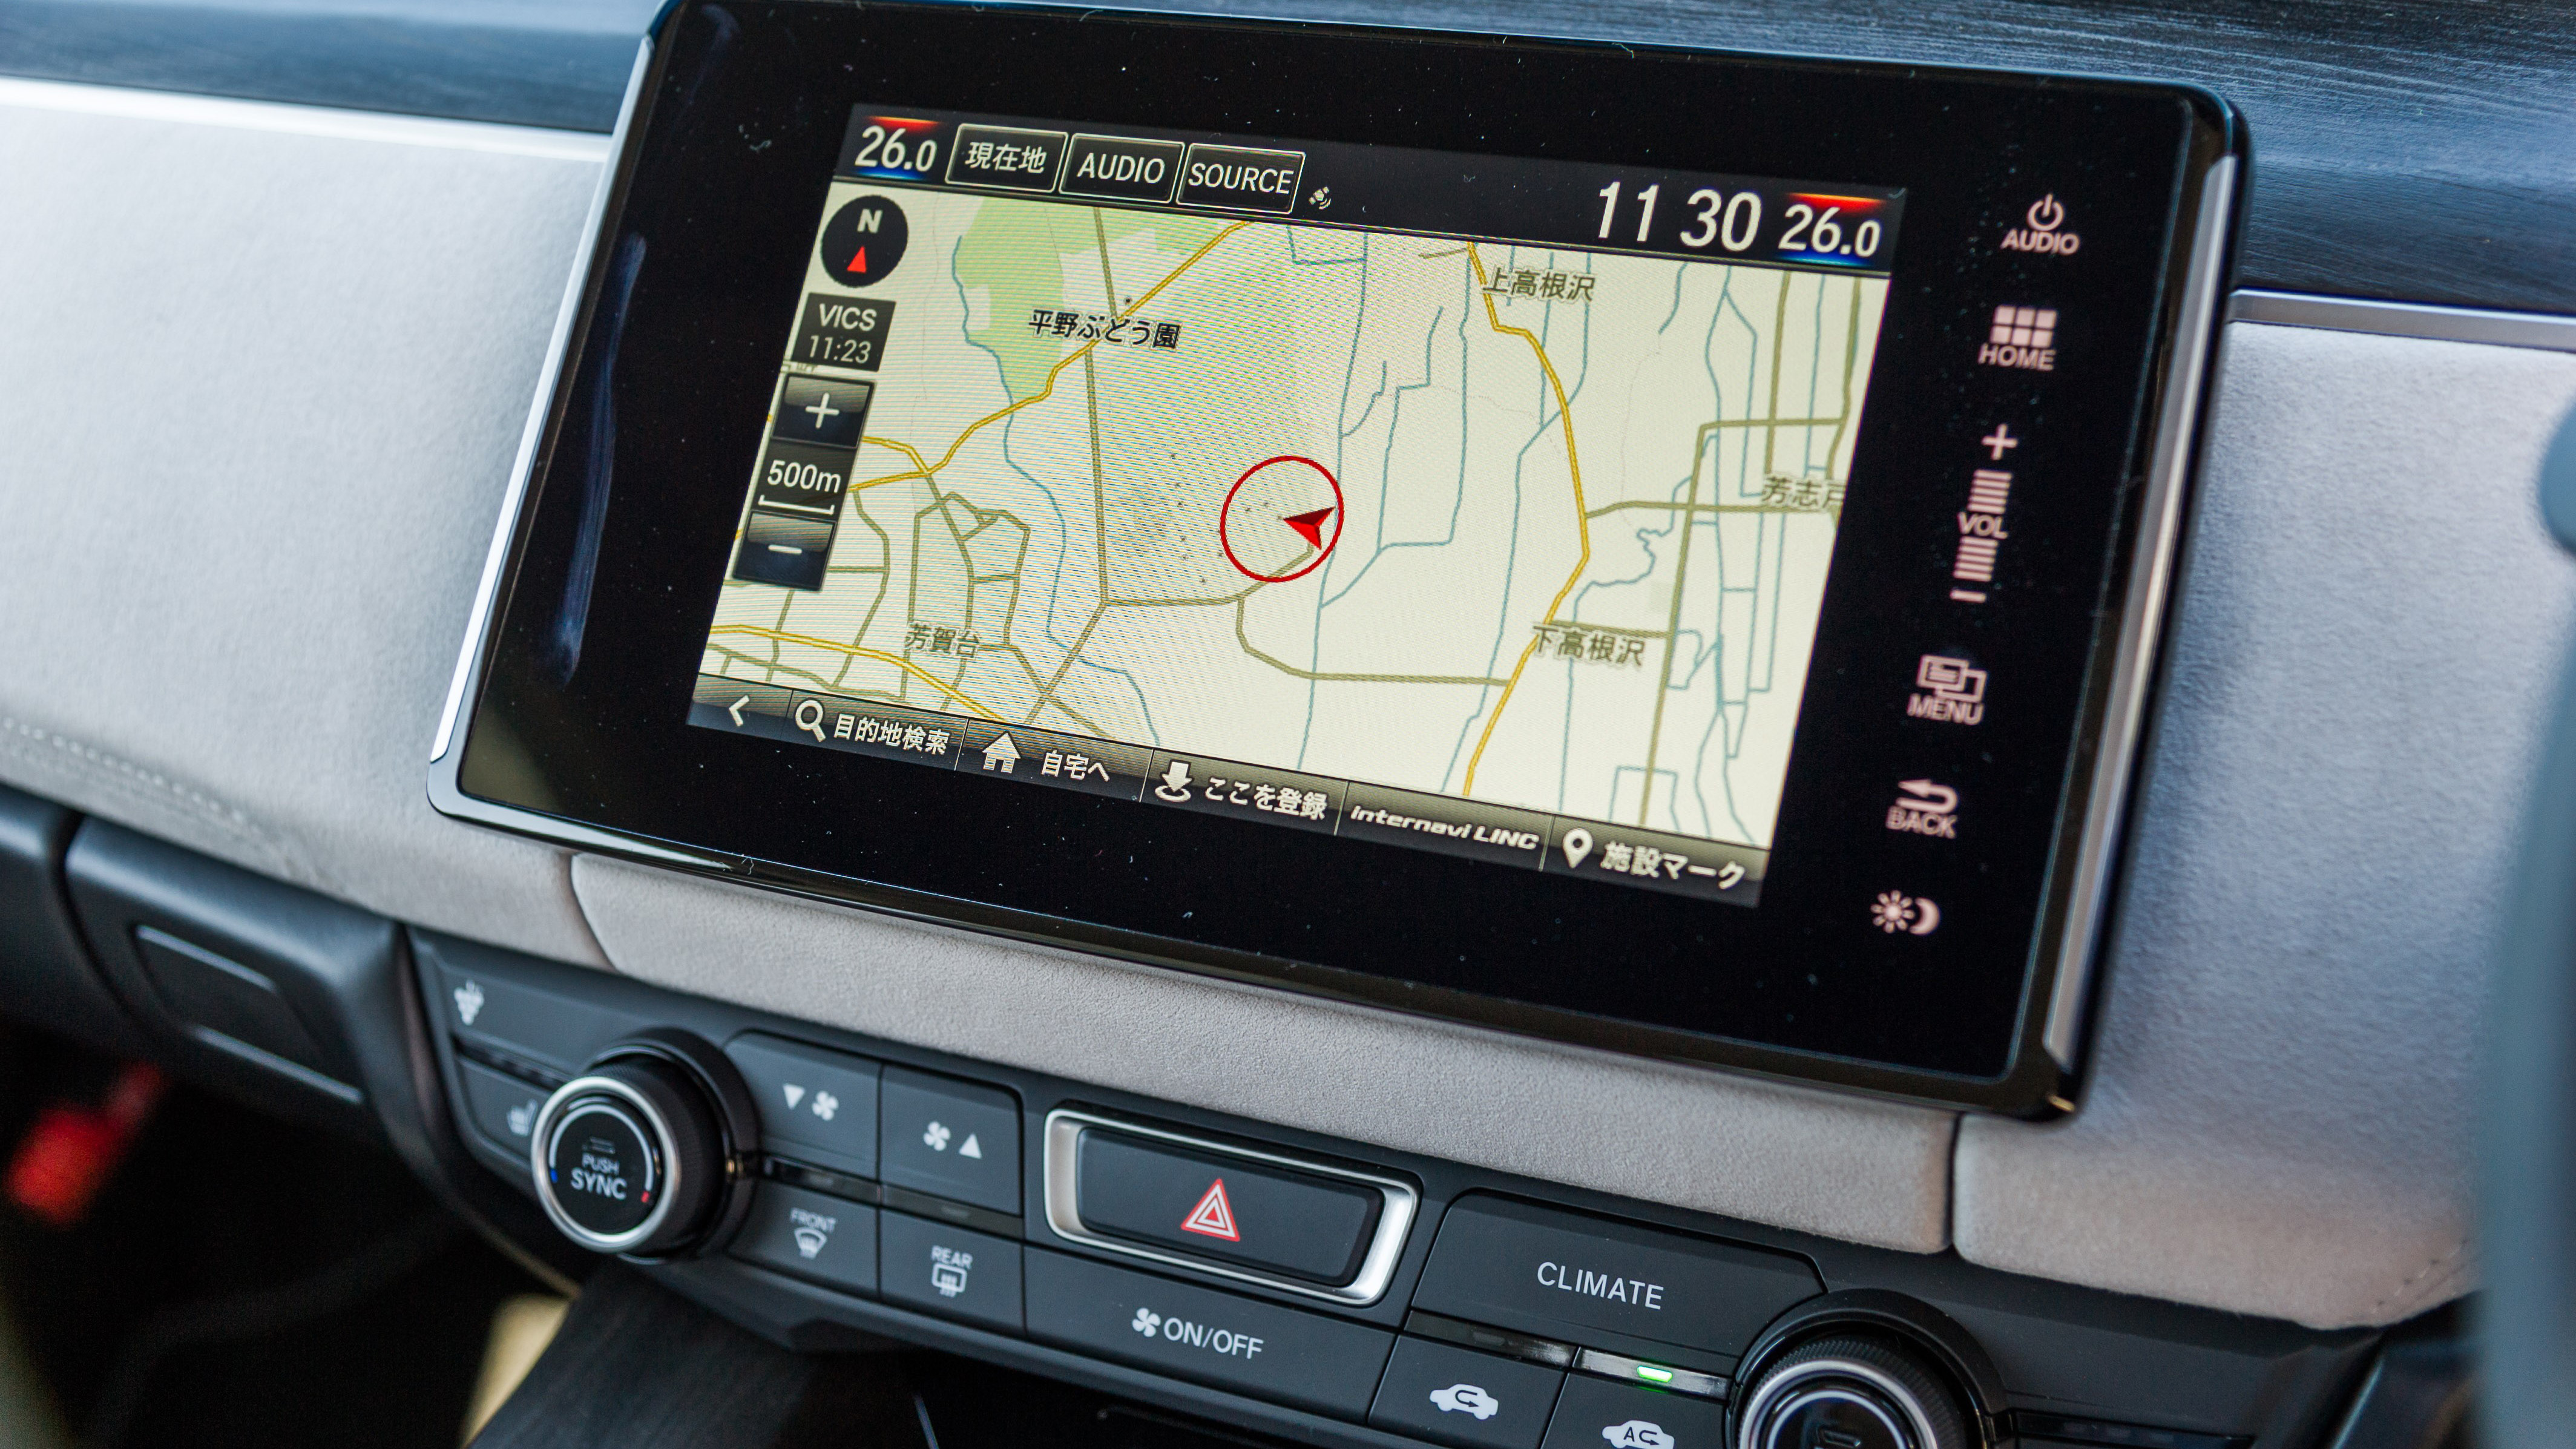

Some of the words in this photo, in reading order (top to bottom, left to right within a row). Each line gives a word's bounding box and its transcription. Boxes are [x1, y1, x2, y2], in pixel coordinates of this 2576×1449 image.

[855, 125, 938, 172] 26.0
[964, 142, 1047, 175] 現在地
[1076, 152, 1166, 184] AUDIO
[1188, 162, 1294, 196] SOURCE
[858, 208, 883, 234] N
[1598, 181, 1661, 242] 11
[1680, 189, 1762, 252] 30
[1778, 203, 1881, 258] 26.0
[2000, 228, 2080, 255] AUDIO
[1482, 266, 1597, 302] 上高根沢
[818, 303, 877, 330] VICS
[1028, 308, 1181, 351] 平野ぶどう園
[809, 335, 872, 364] 11:23
[1977, 343, 2056, 372] HOME
[767, 459, 842, 493] 500m
[1957, 511, 2009, 540] VOL
[904, 623, 980, 660] 芳賀台
[1531, 624, 1646, 667] 下高根沢
[1907, 692, 1985, 726] MENU
[833, 714, 951, 756] 目的地検索
[1040, 749, 1110, 783] 自宅へ
[1204, 777, 1329, 821] ここを登録
[1473, 825, 1539, 851] LINC
[1885, 805, 1957, 840] BACK
[1600, 842, 1746, 889] 施設マーク
[582, 1152, 620, 1175] PUSH
[571, 1168, 627, 1200] SYNC
[790, 1208, 837, 1234] FRONT
[931, 1245, 973, 1270] REAR
[1536, 1261, 1665, 1311] CLIMATE
[1163, 1317, 1264, 1361] ON/OFF
